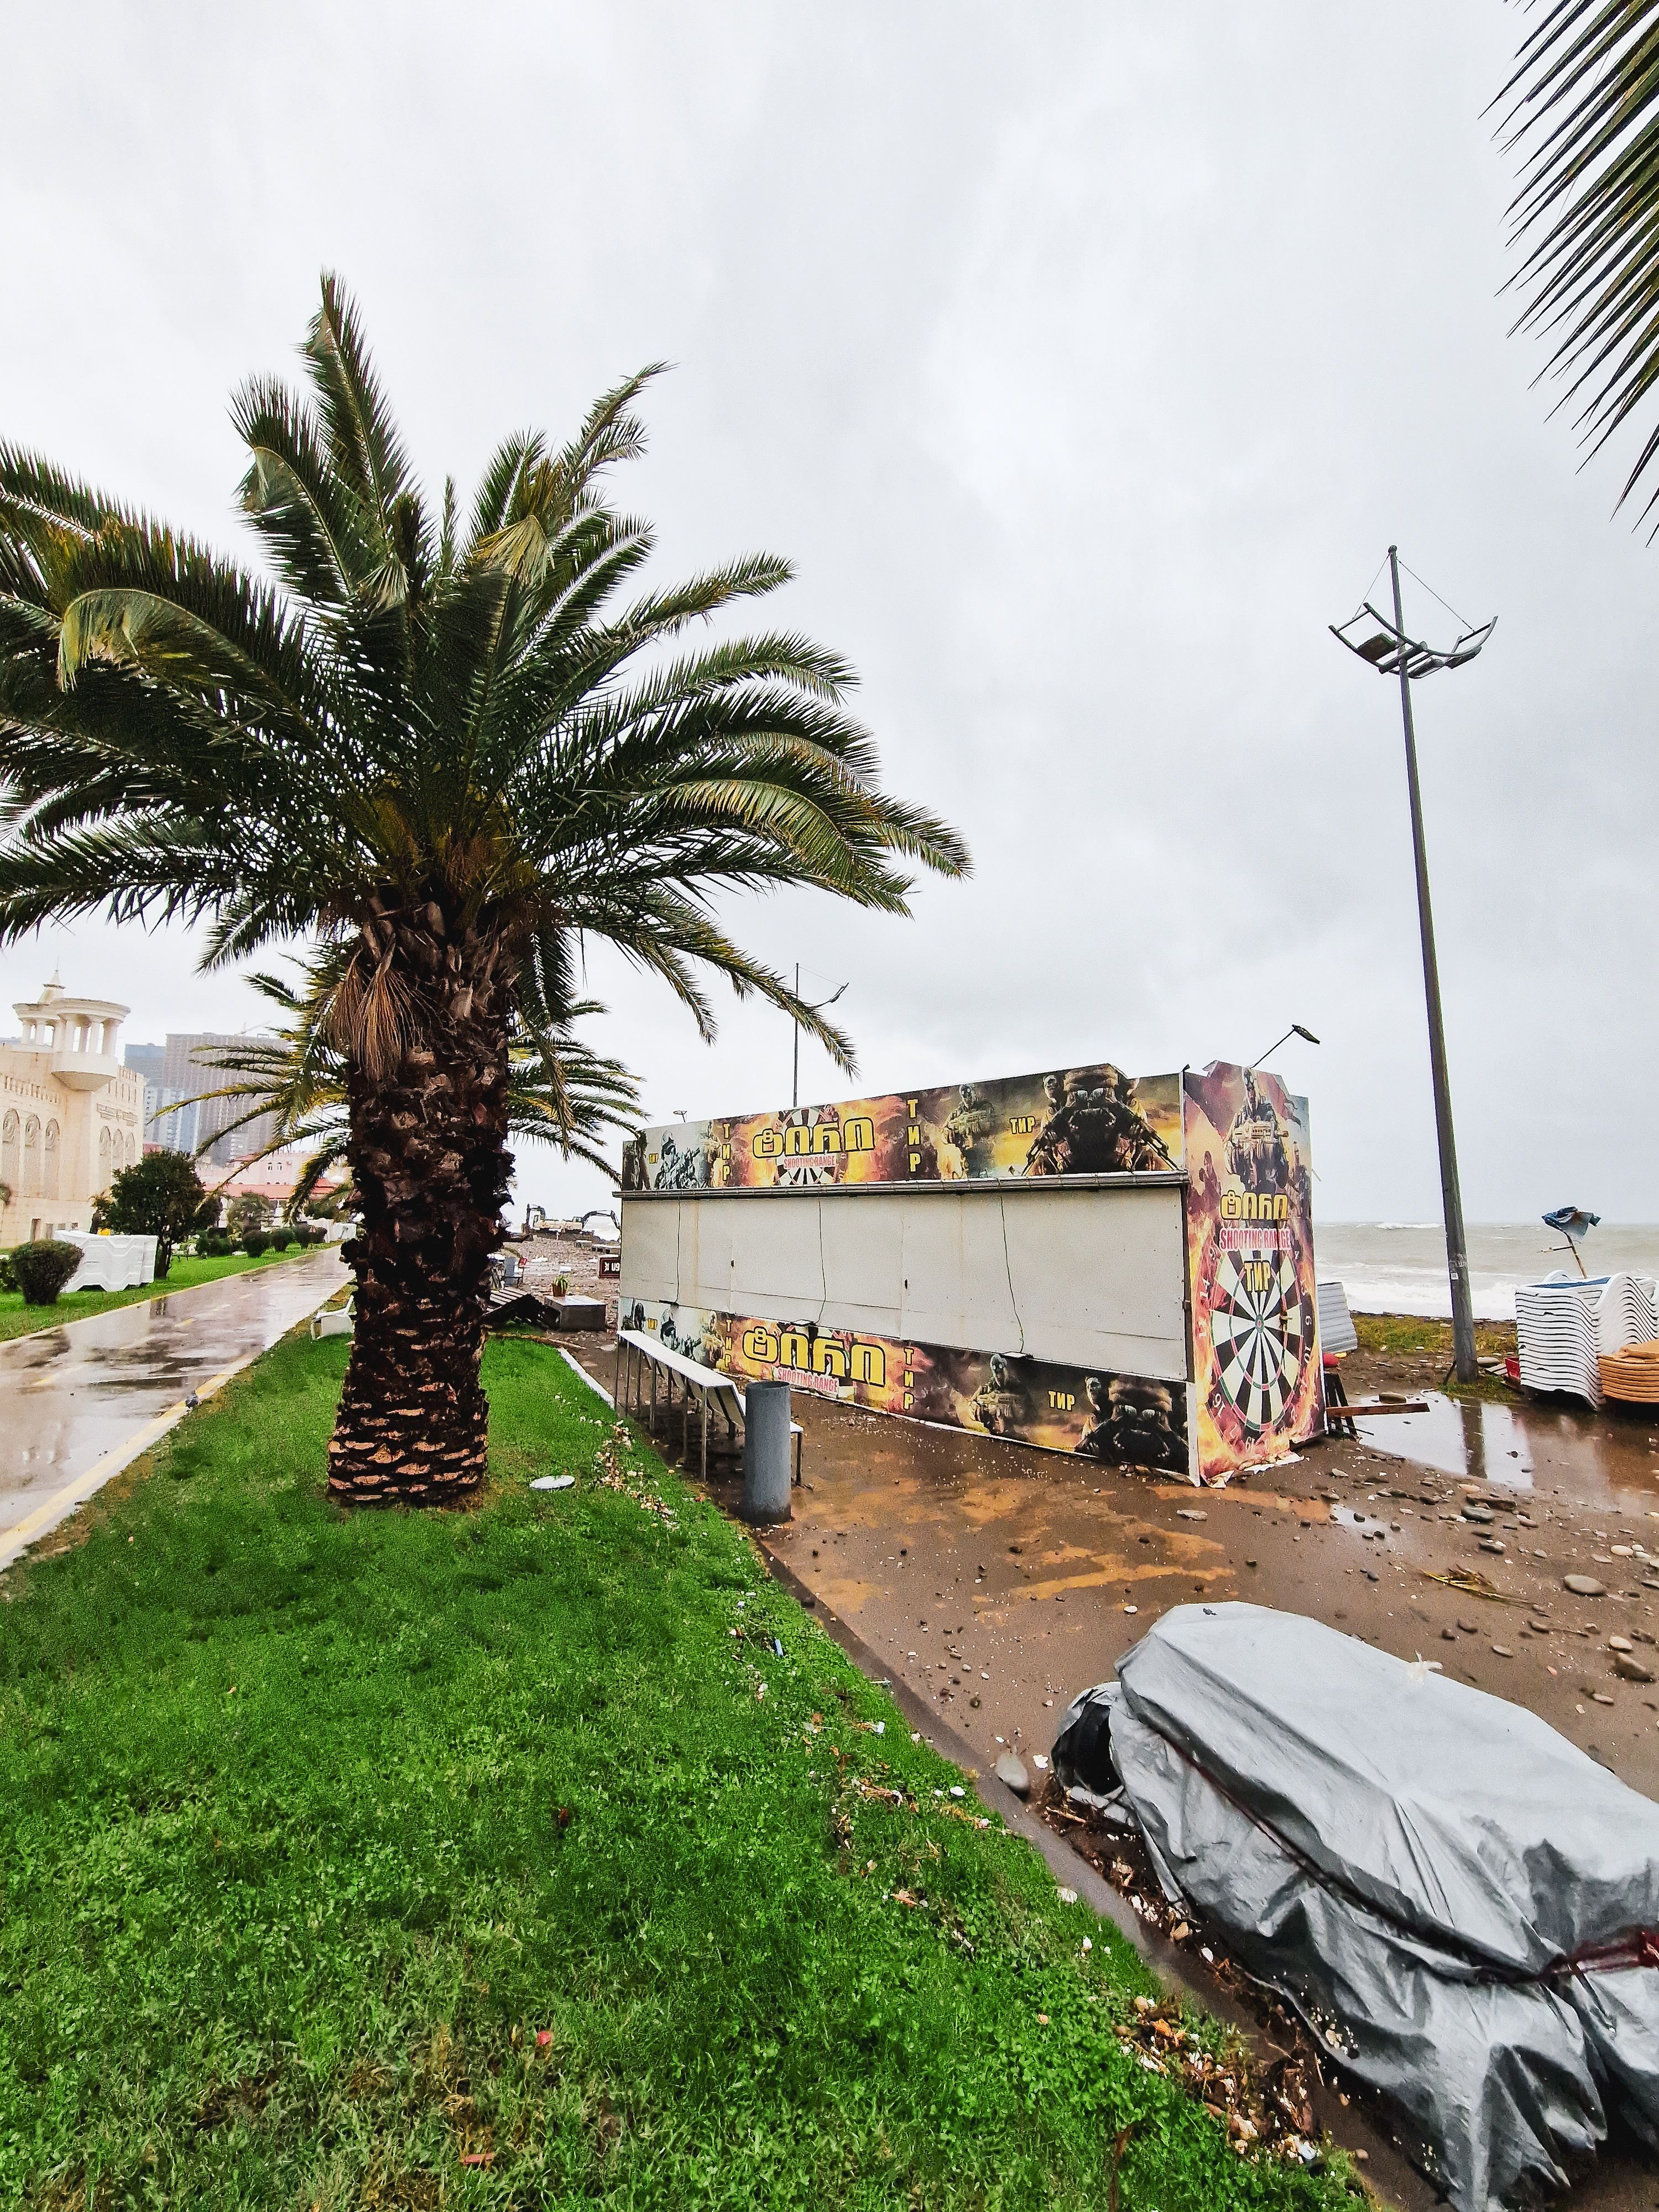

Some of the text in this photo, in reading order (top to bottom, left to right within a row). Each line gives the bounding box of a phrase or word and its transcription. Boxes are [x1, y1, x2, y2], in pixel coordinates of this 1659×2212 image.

[753, 1117, 875, 1159] ტირი
[906, 1098, 922, 1173] ТИР
[1010, 1116, 1036, 1134] ТИР
[722, 1123, 731, 1181] ТИР
[784, 1156, 813, 1168] SHOOTING
[814, 1155, 836, 1167] RANGE
[1220, 1190, 1288, 1220] ტირი
[1220, 1229, 1290, 1249] SHOOTING RANGE
[1244, 1260, 1271, 1292] ТИР
[743, 1326, 885, 1387] ტირი
[778, 1368, 838, 1393] SHOOTING RANGE
[903, 1347, 915, 1411] ТИР
[1047, 1390, 1076, 1412] ТИР
